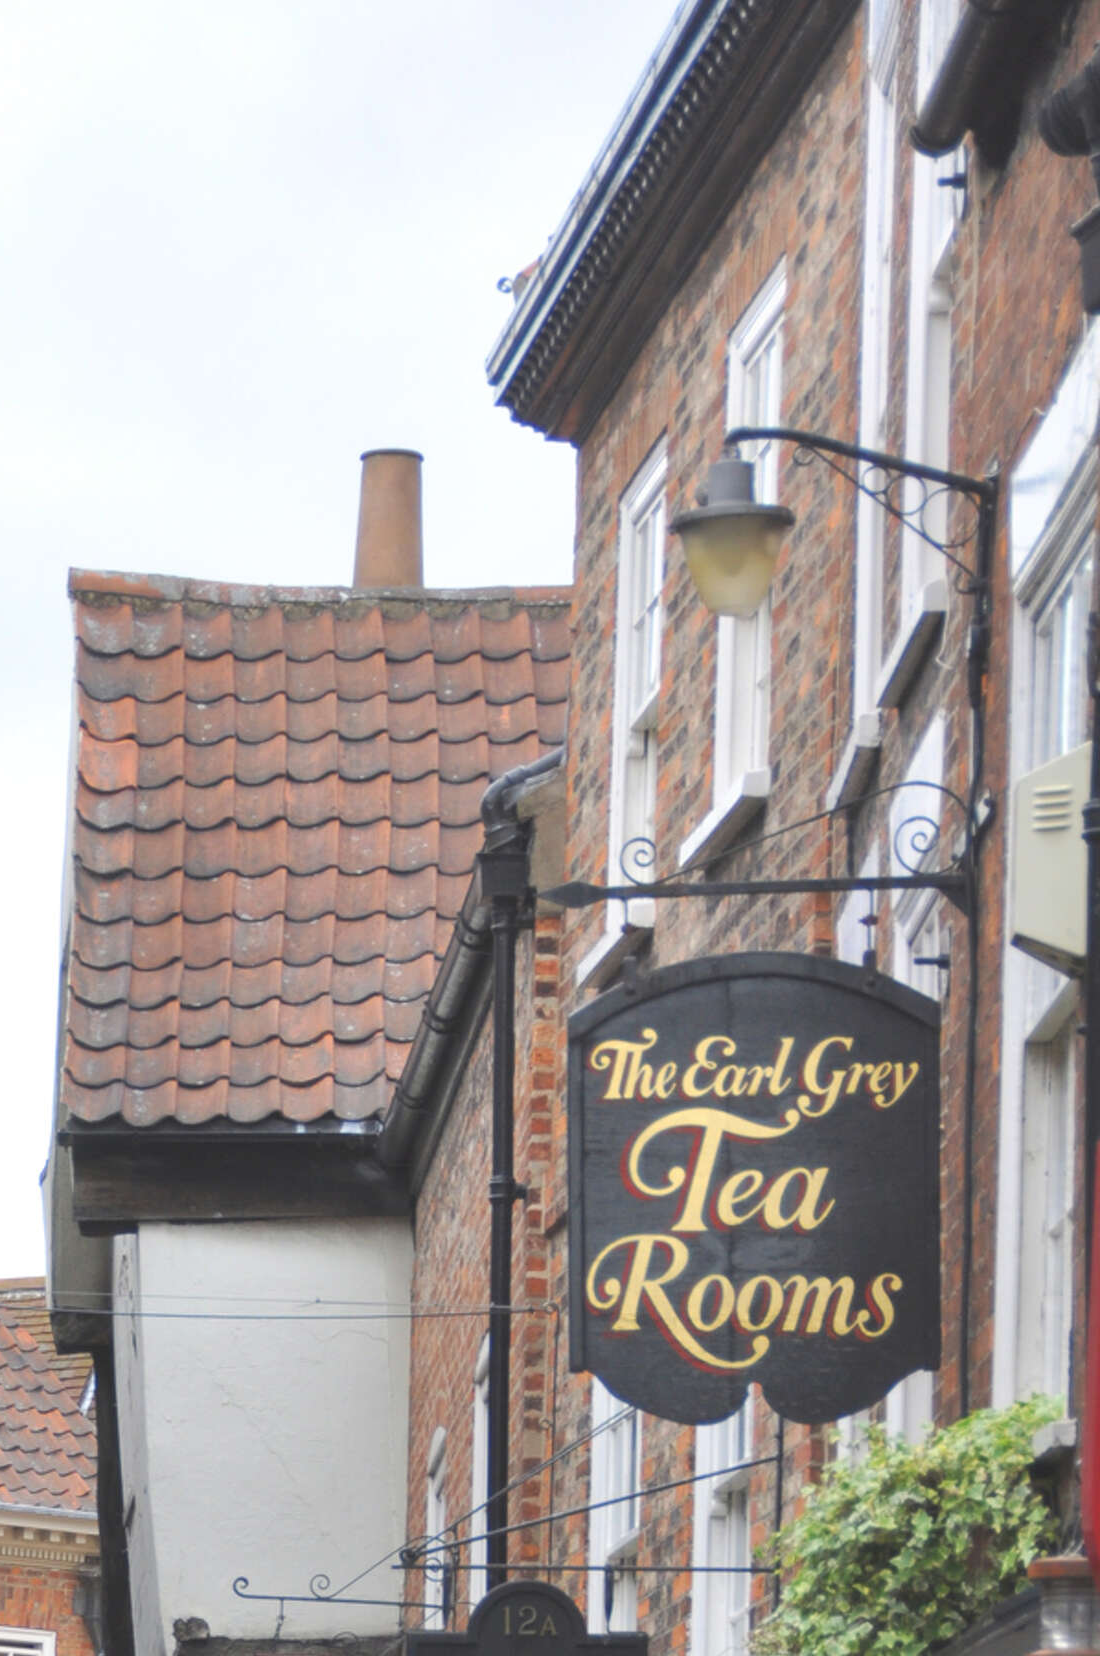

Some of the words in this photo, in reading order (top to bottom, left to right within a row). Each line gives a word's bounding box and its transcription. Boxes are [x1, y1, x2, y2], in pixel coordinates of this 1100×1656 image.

[590, 1028, 677, 1100] The
[682, 1035, 793, 1098] Earl
[797, 1036, 919, 1118] Grey
[624, 1107, 836, 1233] Tea
[586, 1233, 903, 1370] Rooms
[504, 1605, 557, 1636] 12A
